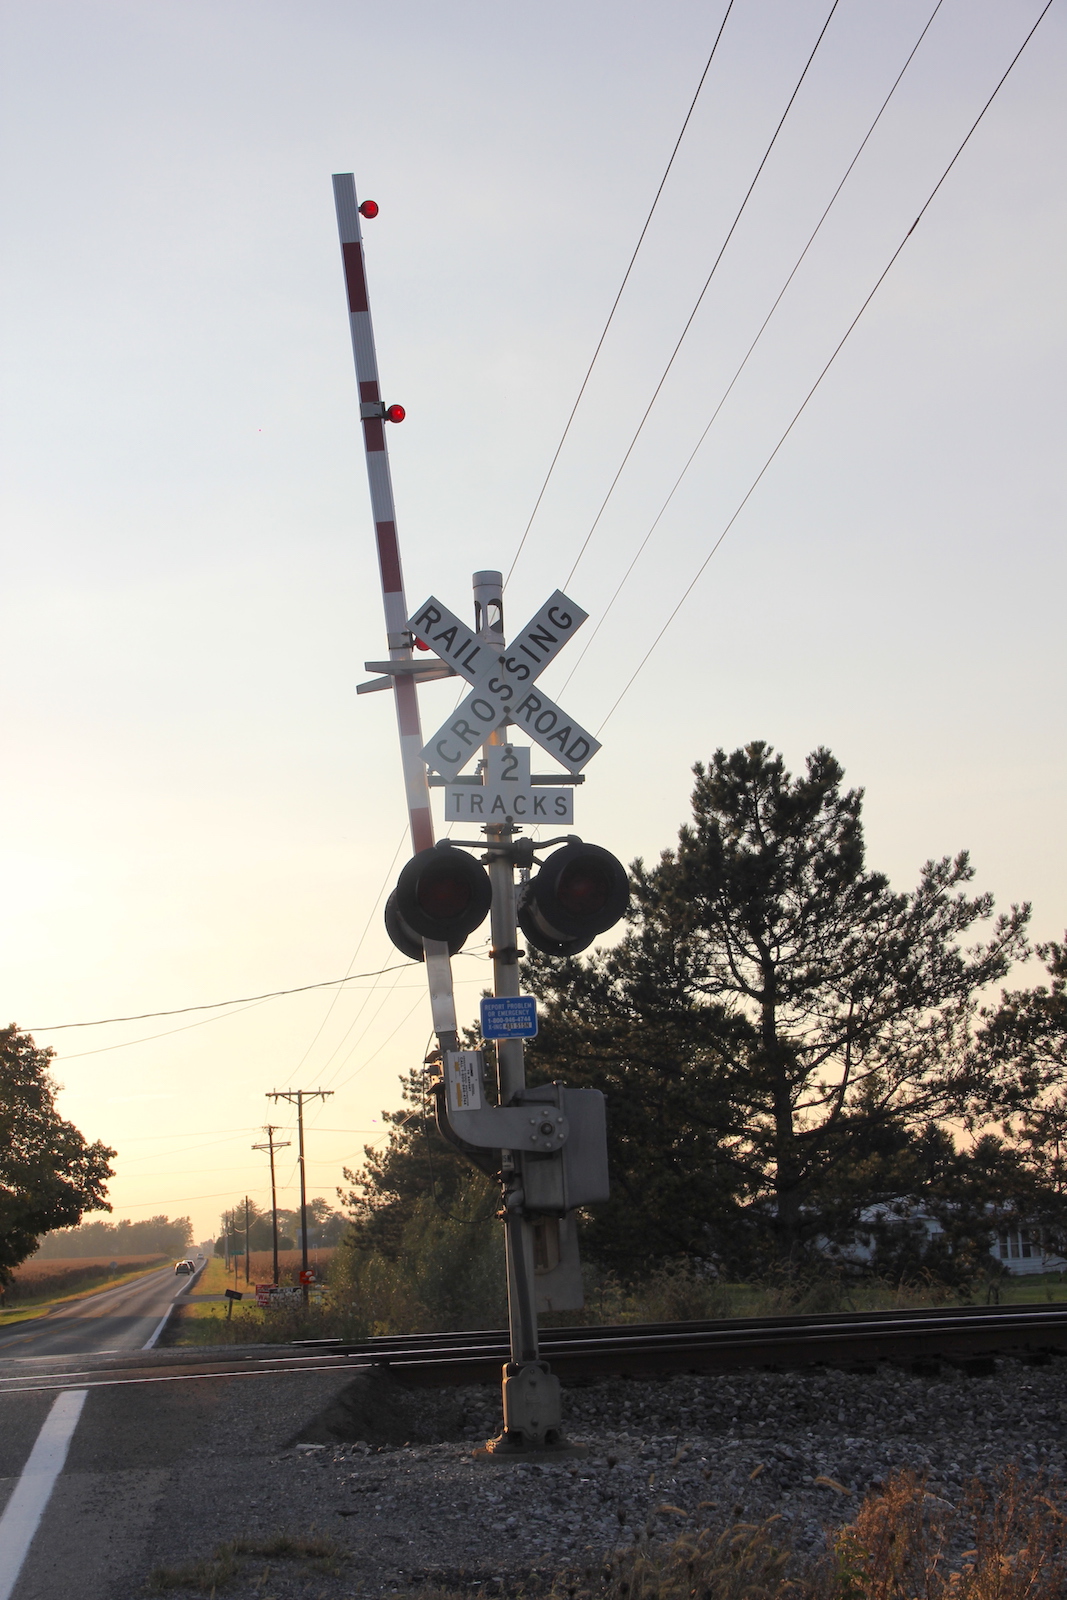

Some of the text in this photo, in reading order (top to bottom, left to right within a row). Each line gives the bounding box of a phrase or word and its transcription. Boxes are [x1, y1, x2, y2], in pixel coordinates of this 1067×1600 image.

[415, 605, 590, 763] RAIL ROAD
[436, 606, 573, 763] CROSSING
[452, 793, 567, 816] TRACKS
[500, 754, 519, 781] 2
